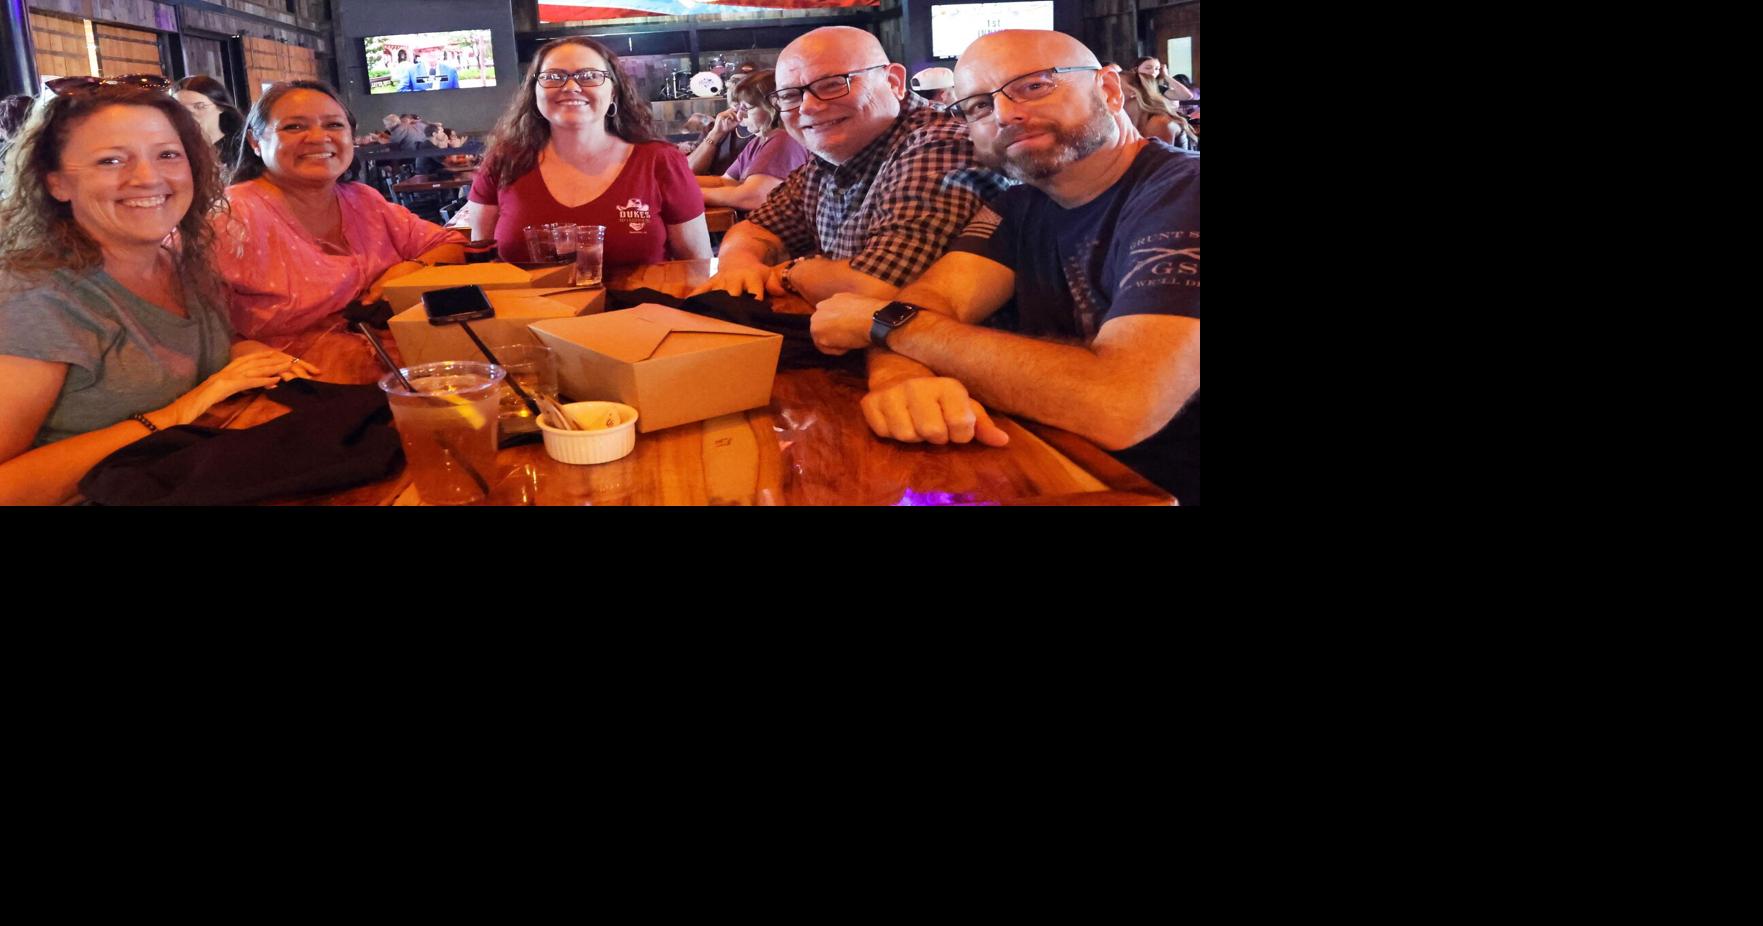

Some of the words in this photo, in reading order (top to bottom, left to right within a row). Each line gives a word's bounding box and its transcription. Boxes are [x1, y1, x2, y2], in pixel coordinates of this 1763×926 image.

[987, 19, 1001, 28] 1st
[1129, 230, 1185, 250] GRUNT
[1151, 262, 1198, 275] GS
